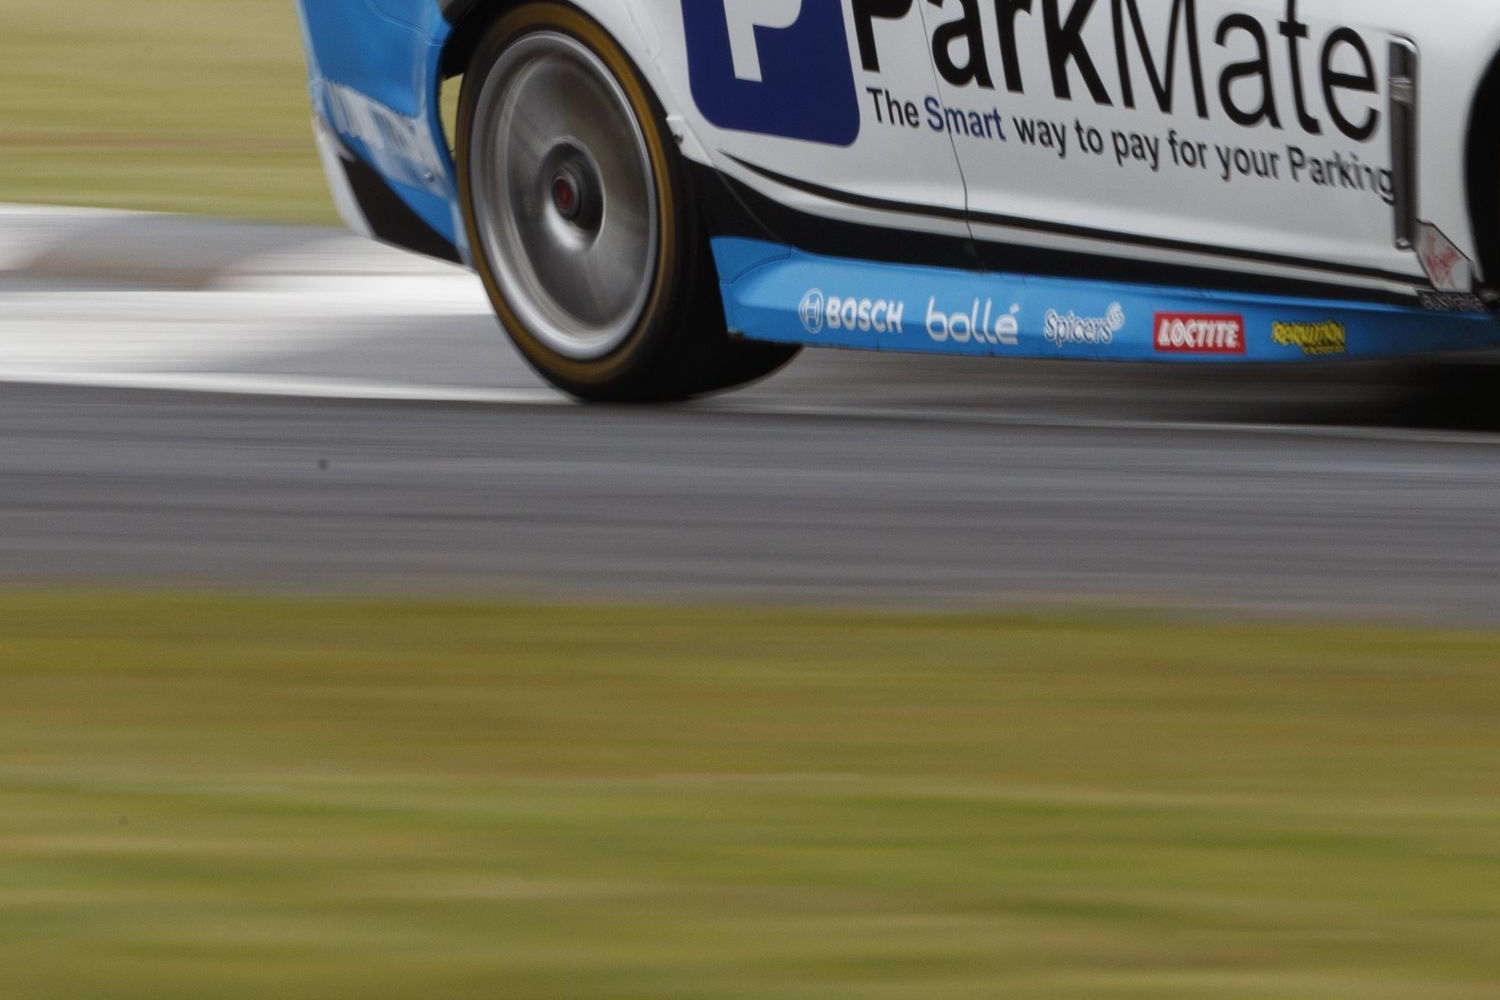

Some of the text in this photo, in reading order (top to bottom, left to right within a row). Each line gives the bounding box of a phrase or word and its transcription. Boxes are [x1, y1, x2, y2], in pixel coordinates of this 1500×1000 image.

[867, 87, 1394, 205] The Smart way to pay for your Parking
[826, 296, 904, 333] BOSCH
[926, 296, 1019, 344] bollé
[1043, 308, 1112, 347] Spicers
[1158, 319, 1239, 348] LOCTITE
